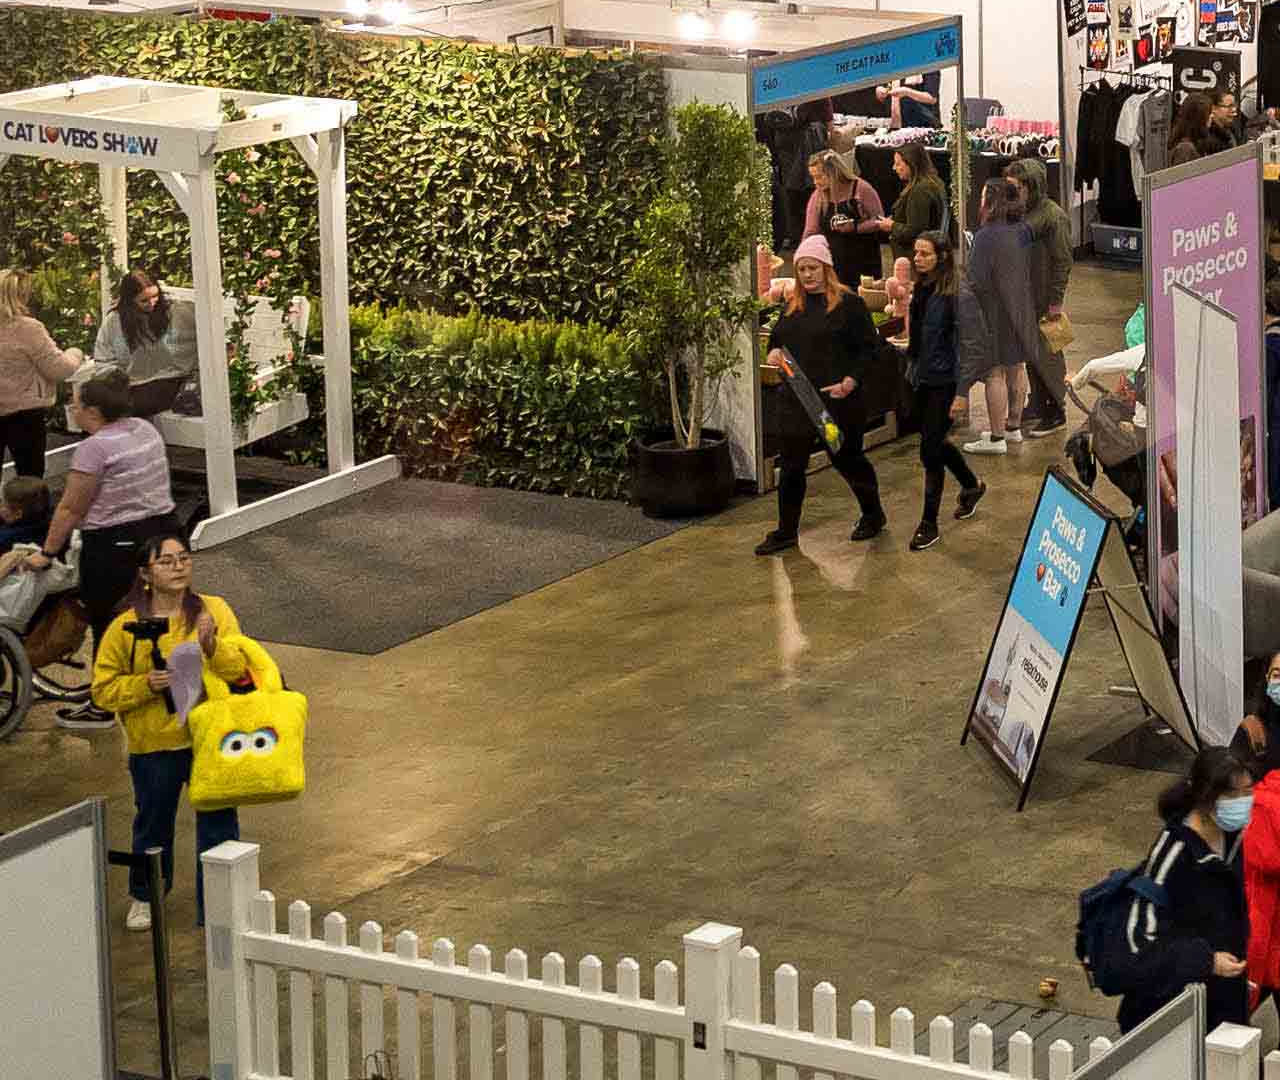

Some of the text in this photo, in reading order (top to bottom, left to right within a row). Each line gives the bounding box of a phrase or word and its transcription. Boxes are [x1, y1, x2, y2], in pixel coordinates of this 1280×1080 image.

[762, 52, 891, 91] 560 THE CAT PARK
[3, 121, 37, 142] CAT
[1172, 211, 1239, 257] Paws &
[1162, 246, 1248, 296] Prosecco
[1052, 504, 1087, 553] Paws &
[1038, 529, 1081, 584] Prosecco
[1042, 567, 1062, 601] Bar
